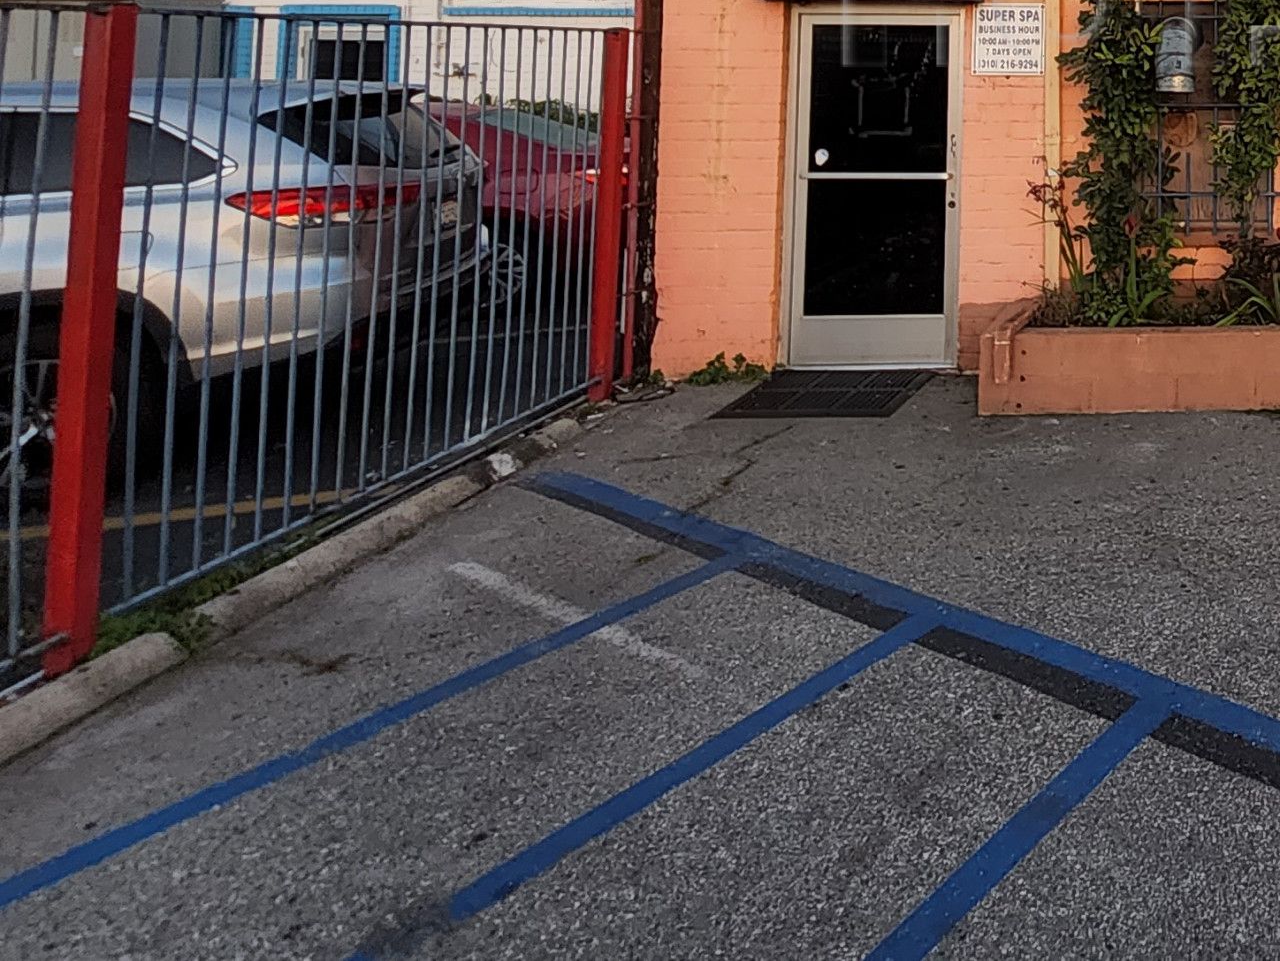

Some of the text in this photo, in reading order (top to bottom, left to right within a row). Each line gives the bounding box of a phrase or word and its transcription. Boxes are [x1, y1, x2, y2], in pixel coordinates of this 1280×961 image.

[979, 9, 1040, 22] SUPER SPA
[978, 25, 1040, 34] BUSINESS HOUR
[992, 48, 1010, 56] DAYS
[1012, 48, 1032, 56] OPEN
[1000, 59, 1038, 70] 216-9294
